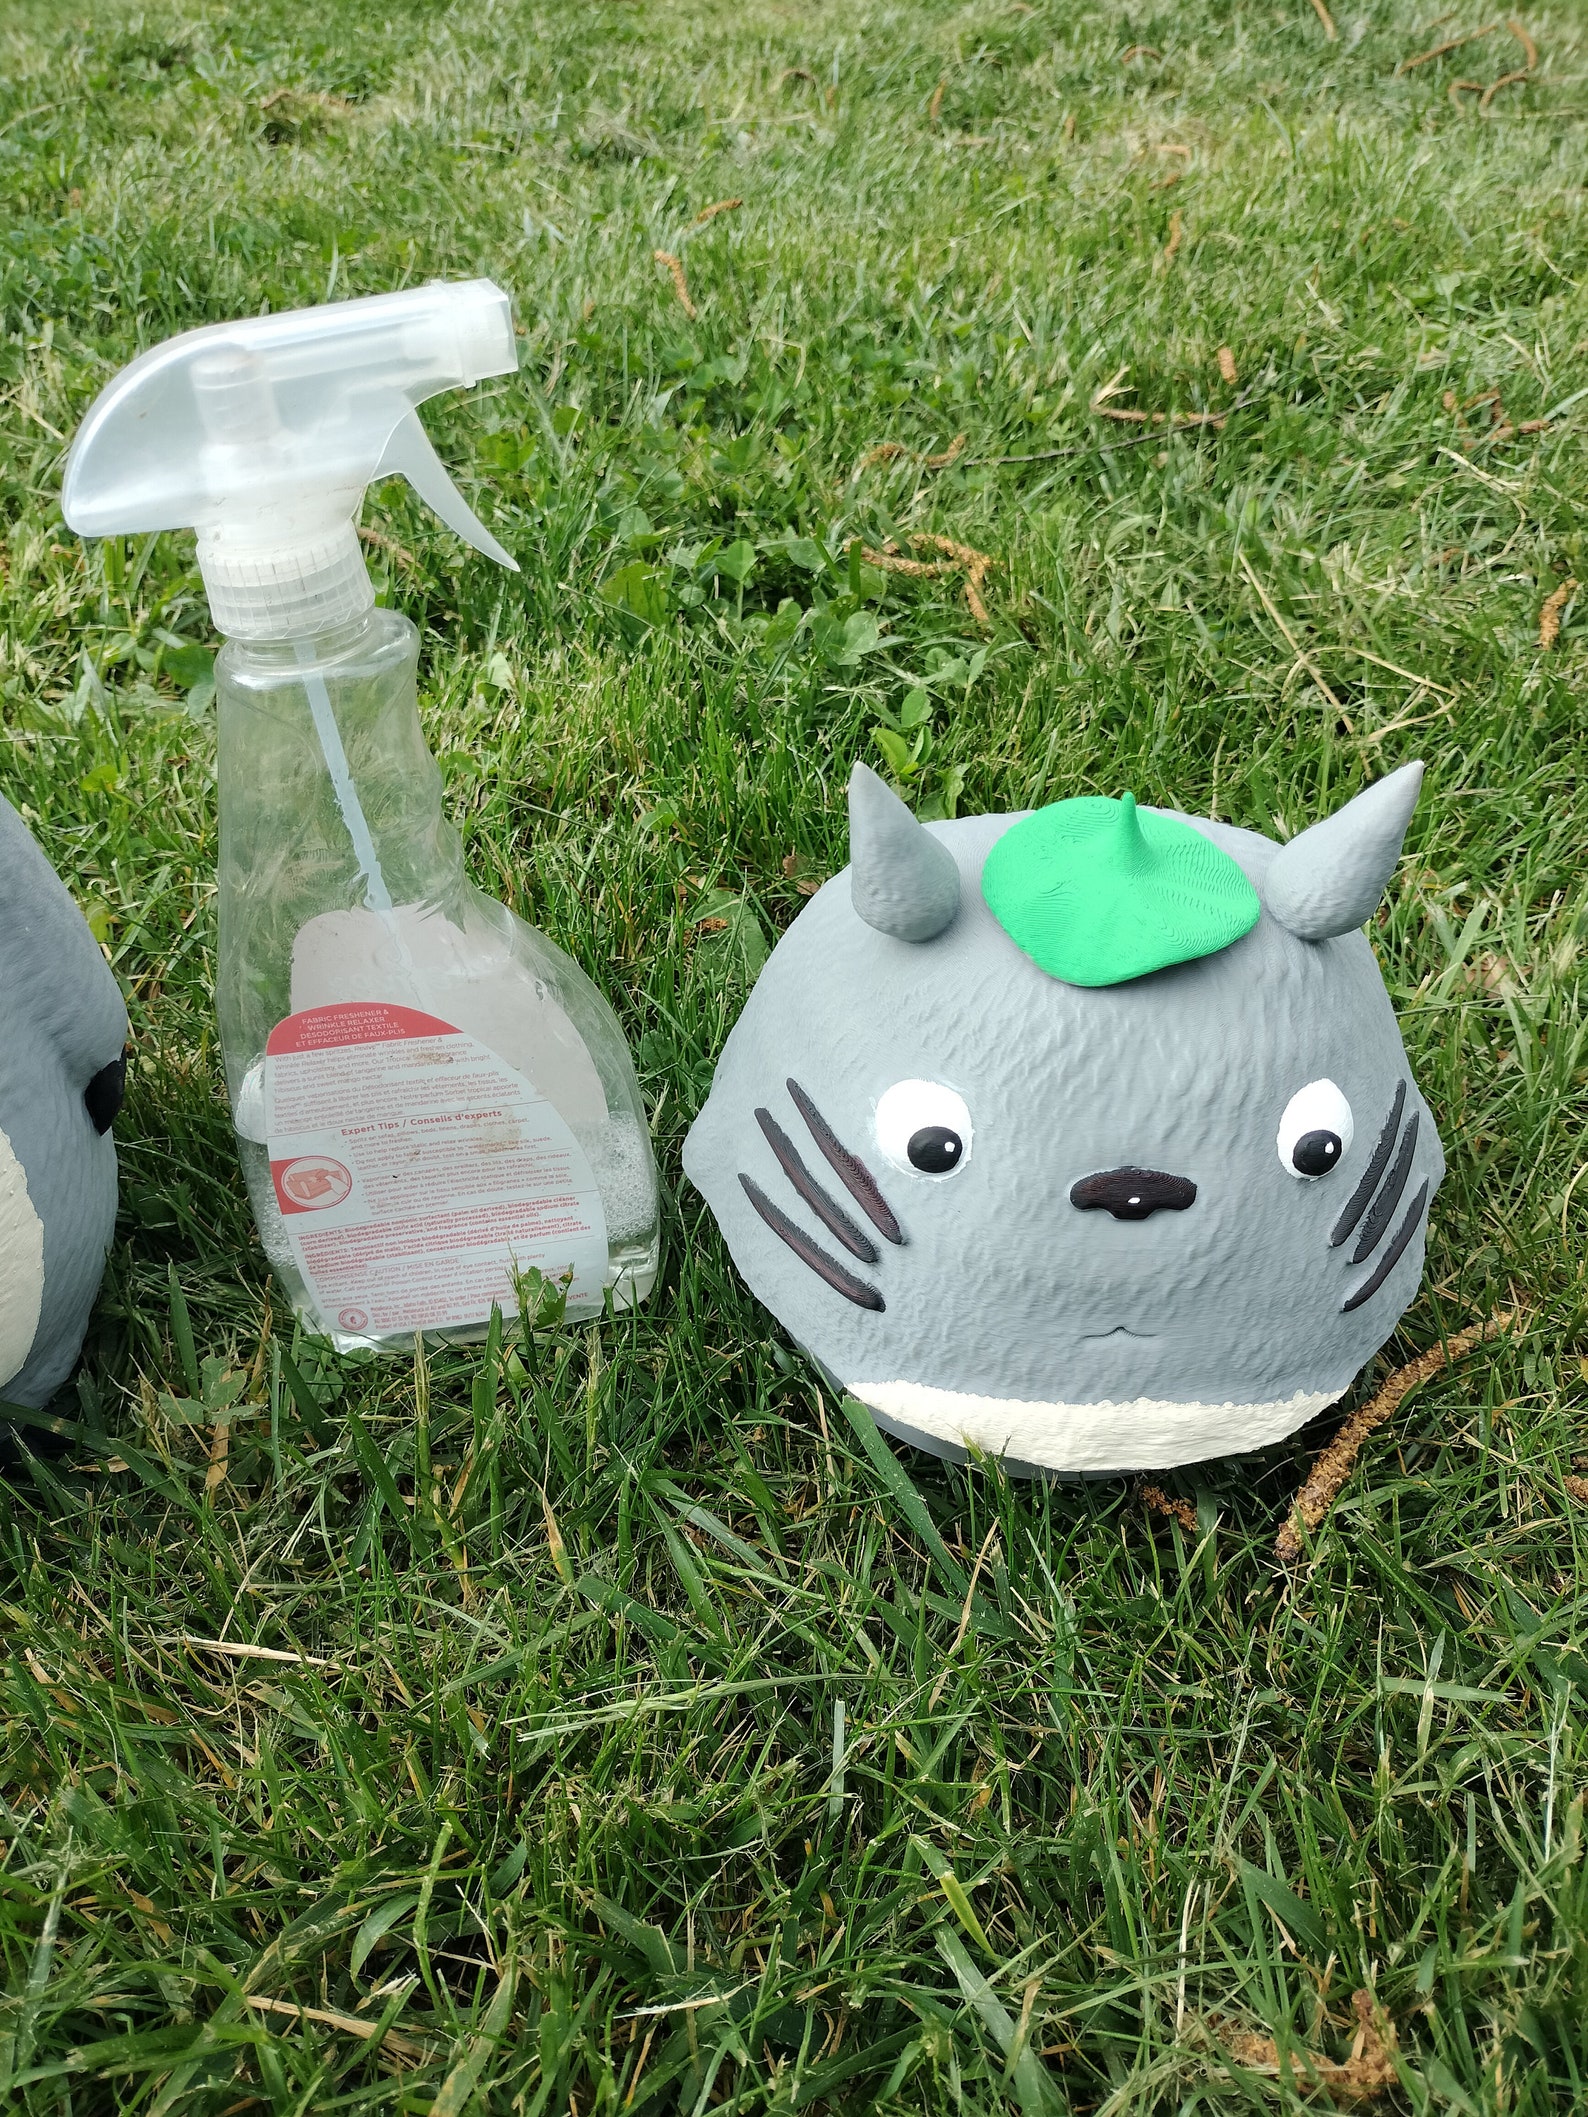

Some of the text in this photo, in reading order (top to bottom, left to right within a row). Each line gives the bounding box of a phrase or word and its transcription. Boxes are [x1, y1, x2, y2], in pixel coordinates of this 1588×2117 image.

[301, 1015, 332, 1025] FABRIC
[333, 1008, 382, 1021] FRESHENER
[307, 1015, 385, 1031] WRINKLE RELAXER
[366, 1020, 399, 1032] TEXTILE
[307, 1034, 350, 1045] EFFACEUR
[364, 1027, 405, 1039] FAUX-PLIS
[275, 1055, 291, 1063] With
[382, 1040, 402, 1048] Fabric
[403, 1036, 436, 1047] Freshener
[275, 1061, 299, 1070] Wrinkle
[301, 1058, 326, 1067] Relaxer
[340, 1107, 502, 1136] Expert Tips / Conseils d'experts
